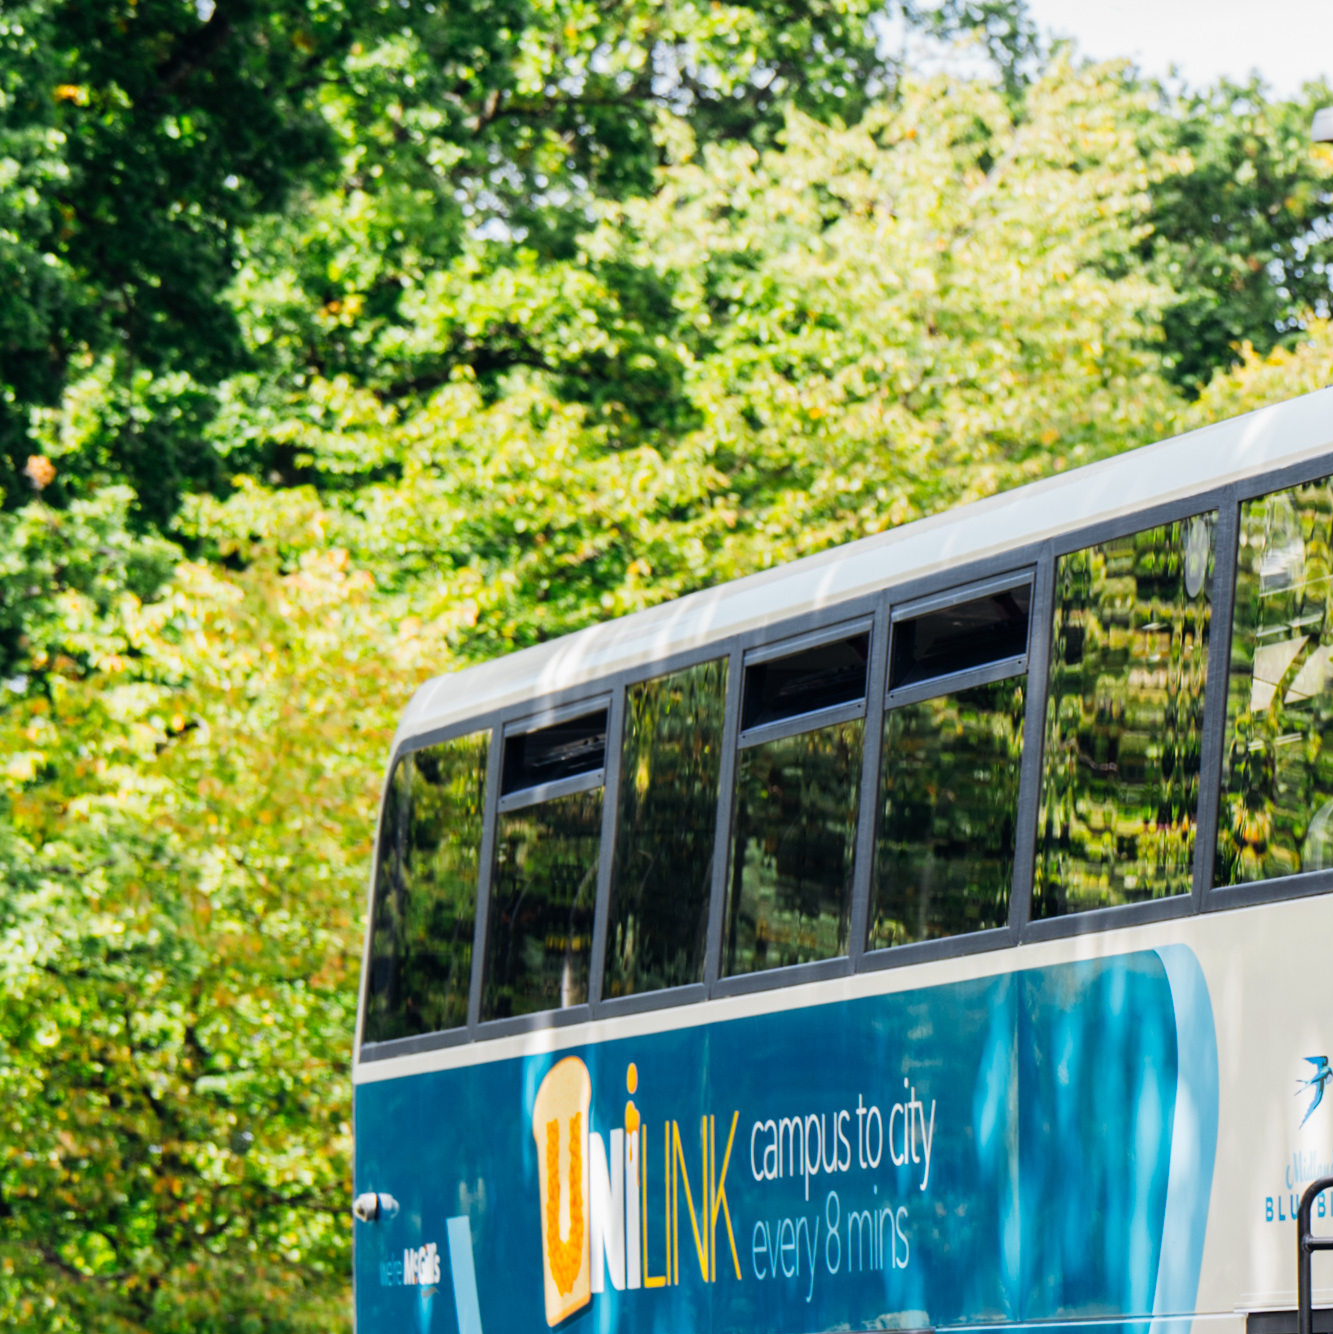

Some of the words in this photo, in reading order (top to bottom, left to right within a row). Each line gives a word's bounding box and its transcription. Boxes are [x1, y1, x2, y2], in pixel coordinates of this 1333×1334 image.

[750, 1109, 851, 1202] campus
[856, 1093, 883, 1170] to
[889, 1077, 937, 1192] city
[752, 1214, 820, 1304] every
[825, 1190, 842, 1275] 8
[848, 1184, 910, 1274] mins
